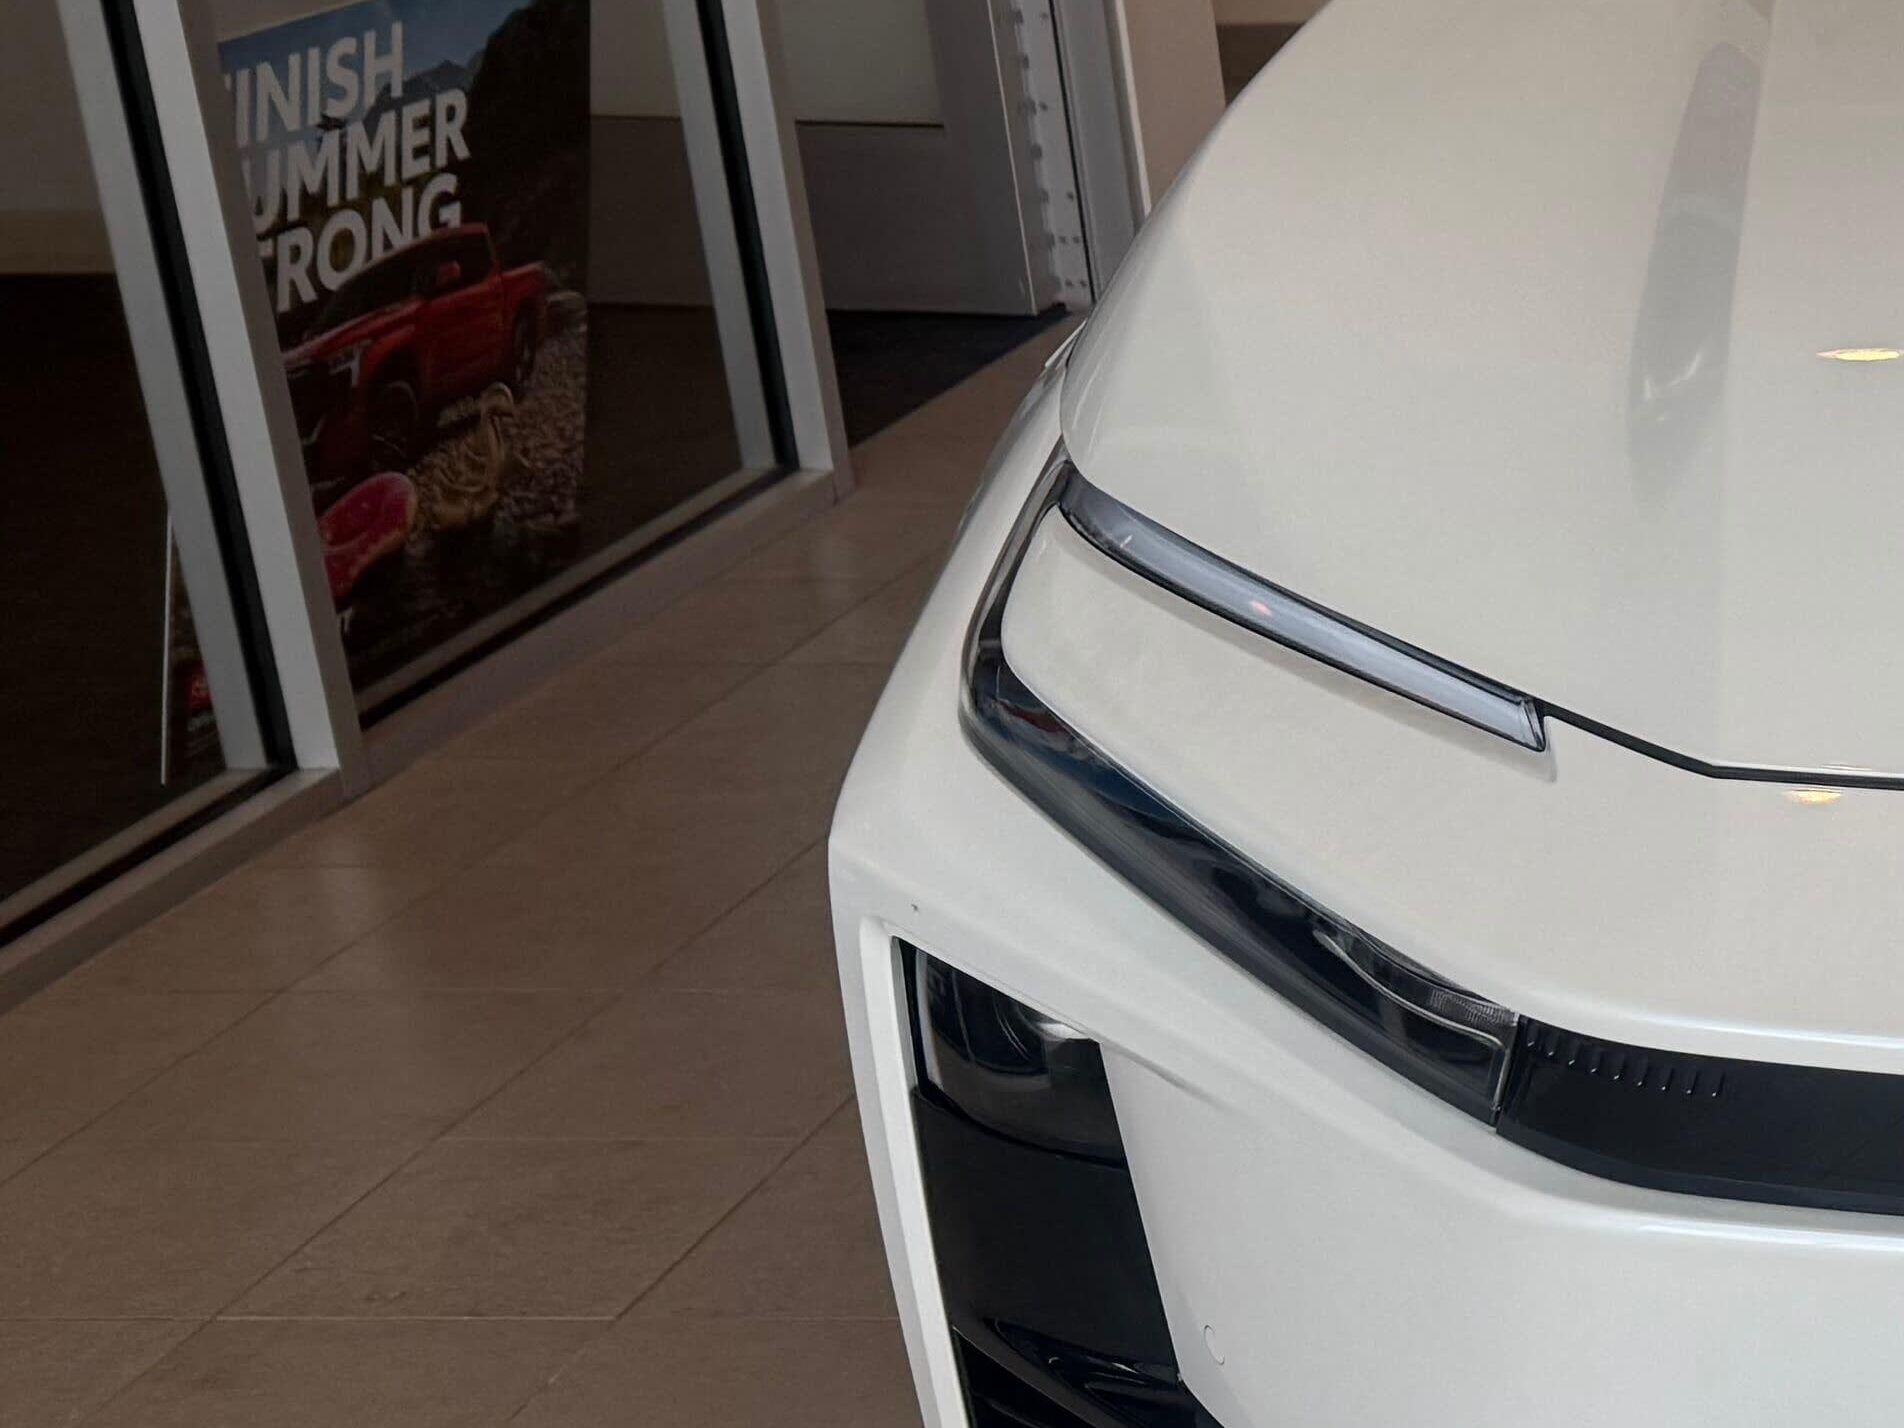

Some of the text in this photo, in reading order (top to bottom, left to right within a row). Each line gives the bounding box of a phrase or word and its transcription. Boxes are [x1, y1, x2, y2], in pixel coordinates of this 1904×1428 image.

[224, 20, 404, 150] INISH
[242, 88, 472, 233] UMMER
[258, 172, 462, 313] RONG
